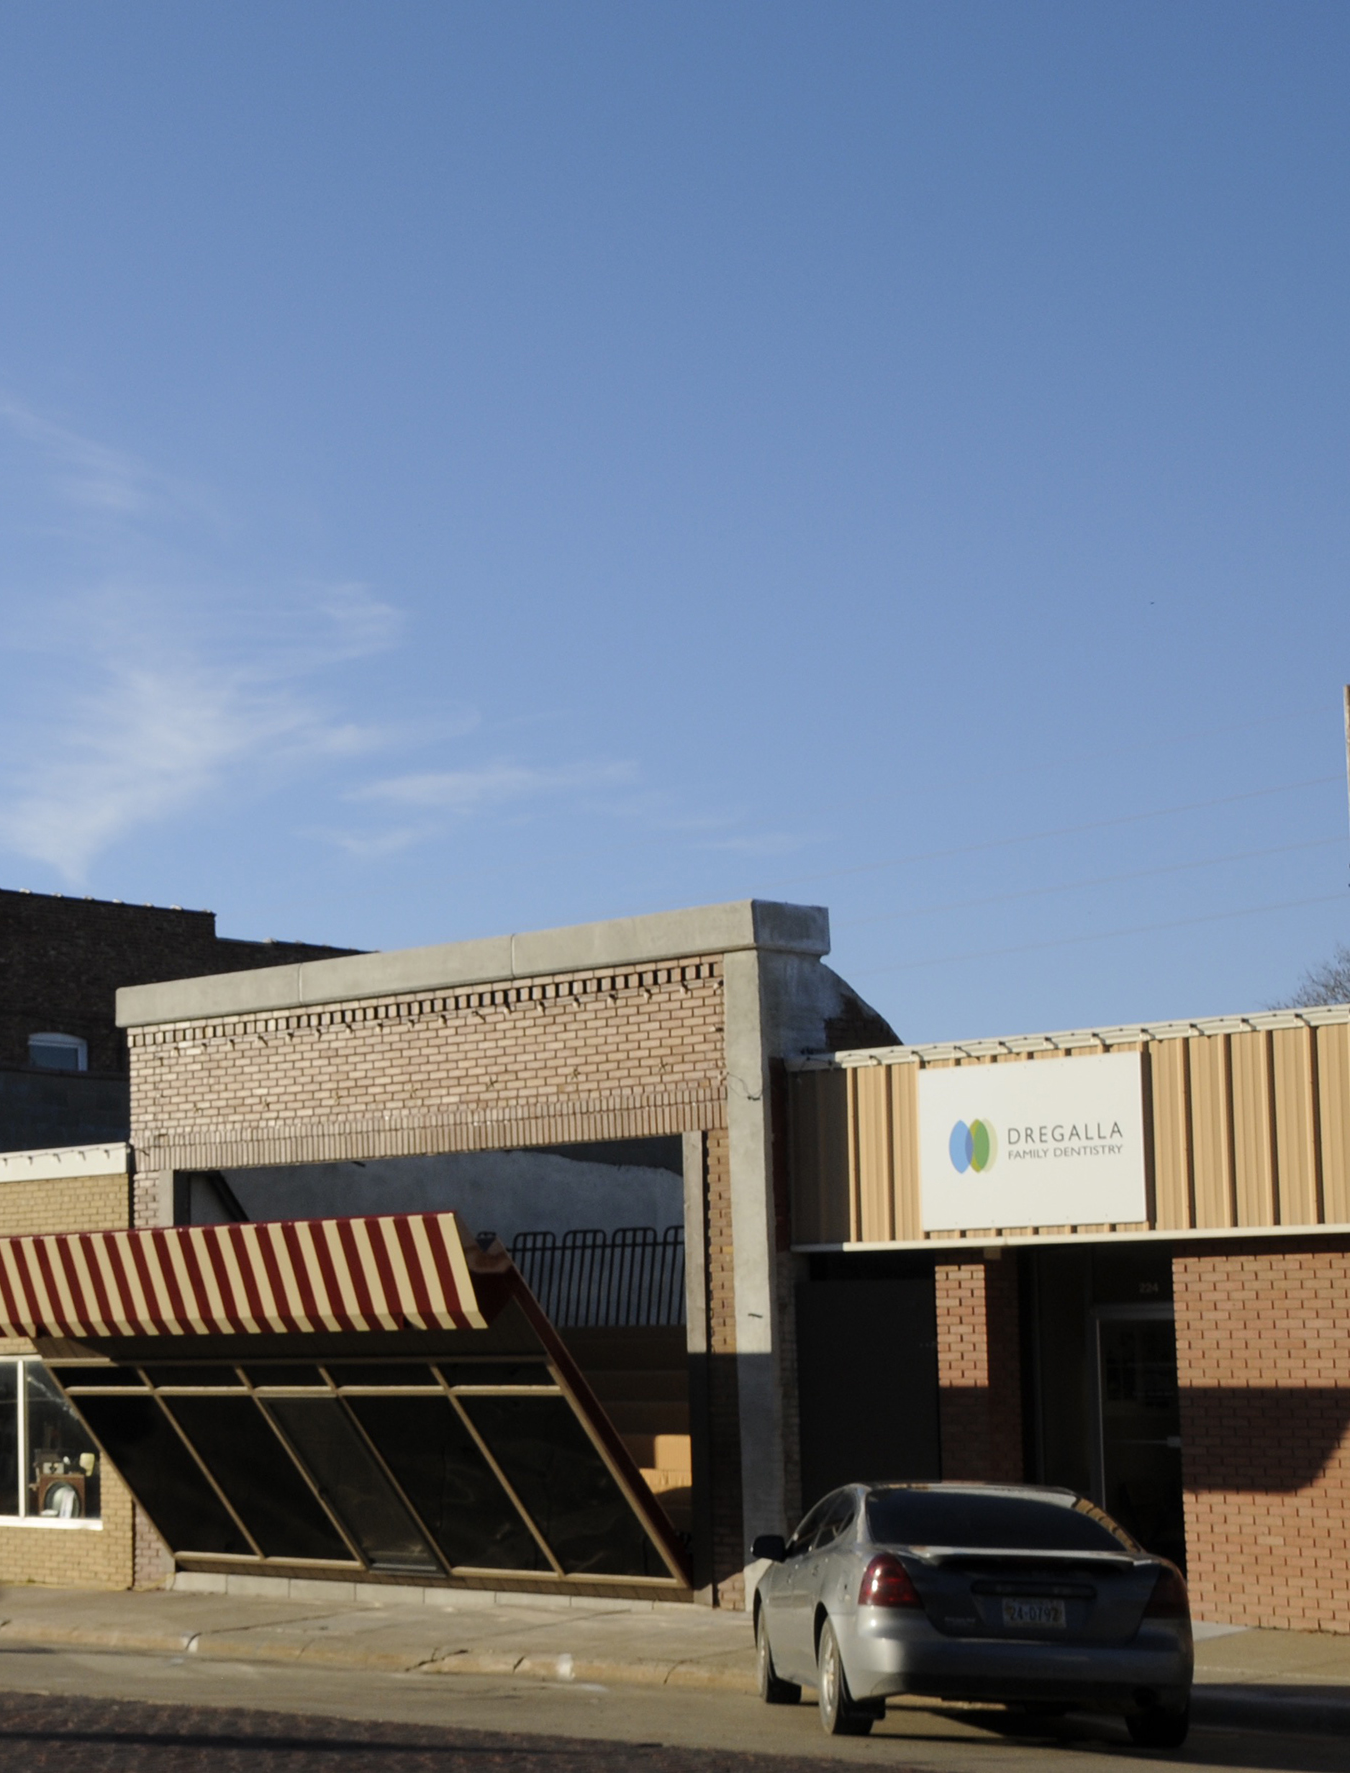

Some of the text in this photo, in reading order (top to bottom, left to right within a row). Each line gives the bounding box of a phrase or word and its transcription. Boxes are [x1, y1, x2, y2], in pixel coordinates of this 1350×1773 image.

[1007, 1121, 1123, 1144] DREGALLA
[1007, 1145, 1123, 1160] FAMILY DENTISTRY
